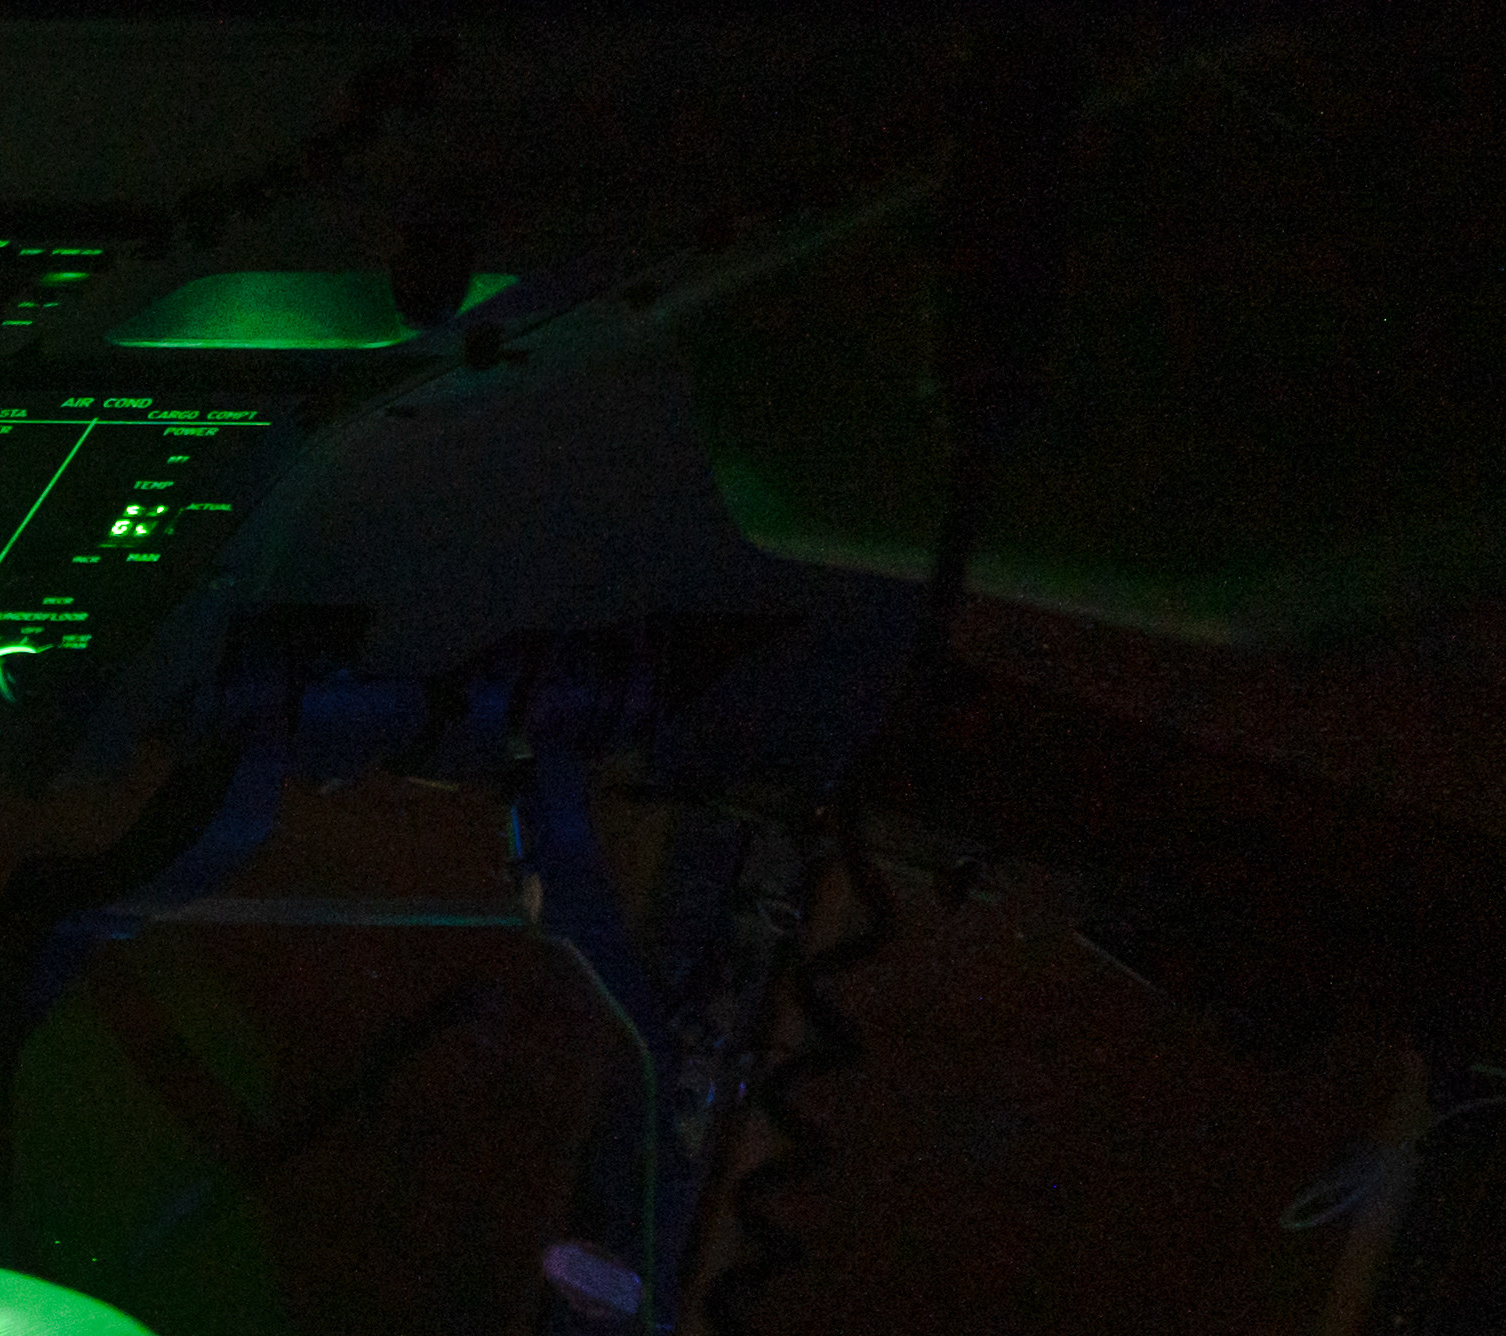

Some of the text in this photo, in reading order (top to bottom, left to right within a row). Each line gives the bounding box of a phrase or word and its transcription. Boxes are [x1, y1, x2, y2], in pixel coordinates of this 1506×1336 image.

[61, 398, 152, 408] AIR COND
[0, 409, 27, 417] STA
[148, 411, 258, 419] CARGO COMPT
[164, 427, 219, 436] POWER
[134, 481, 174, 489] TEMP
